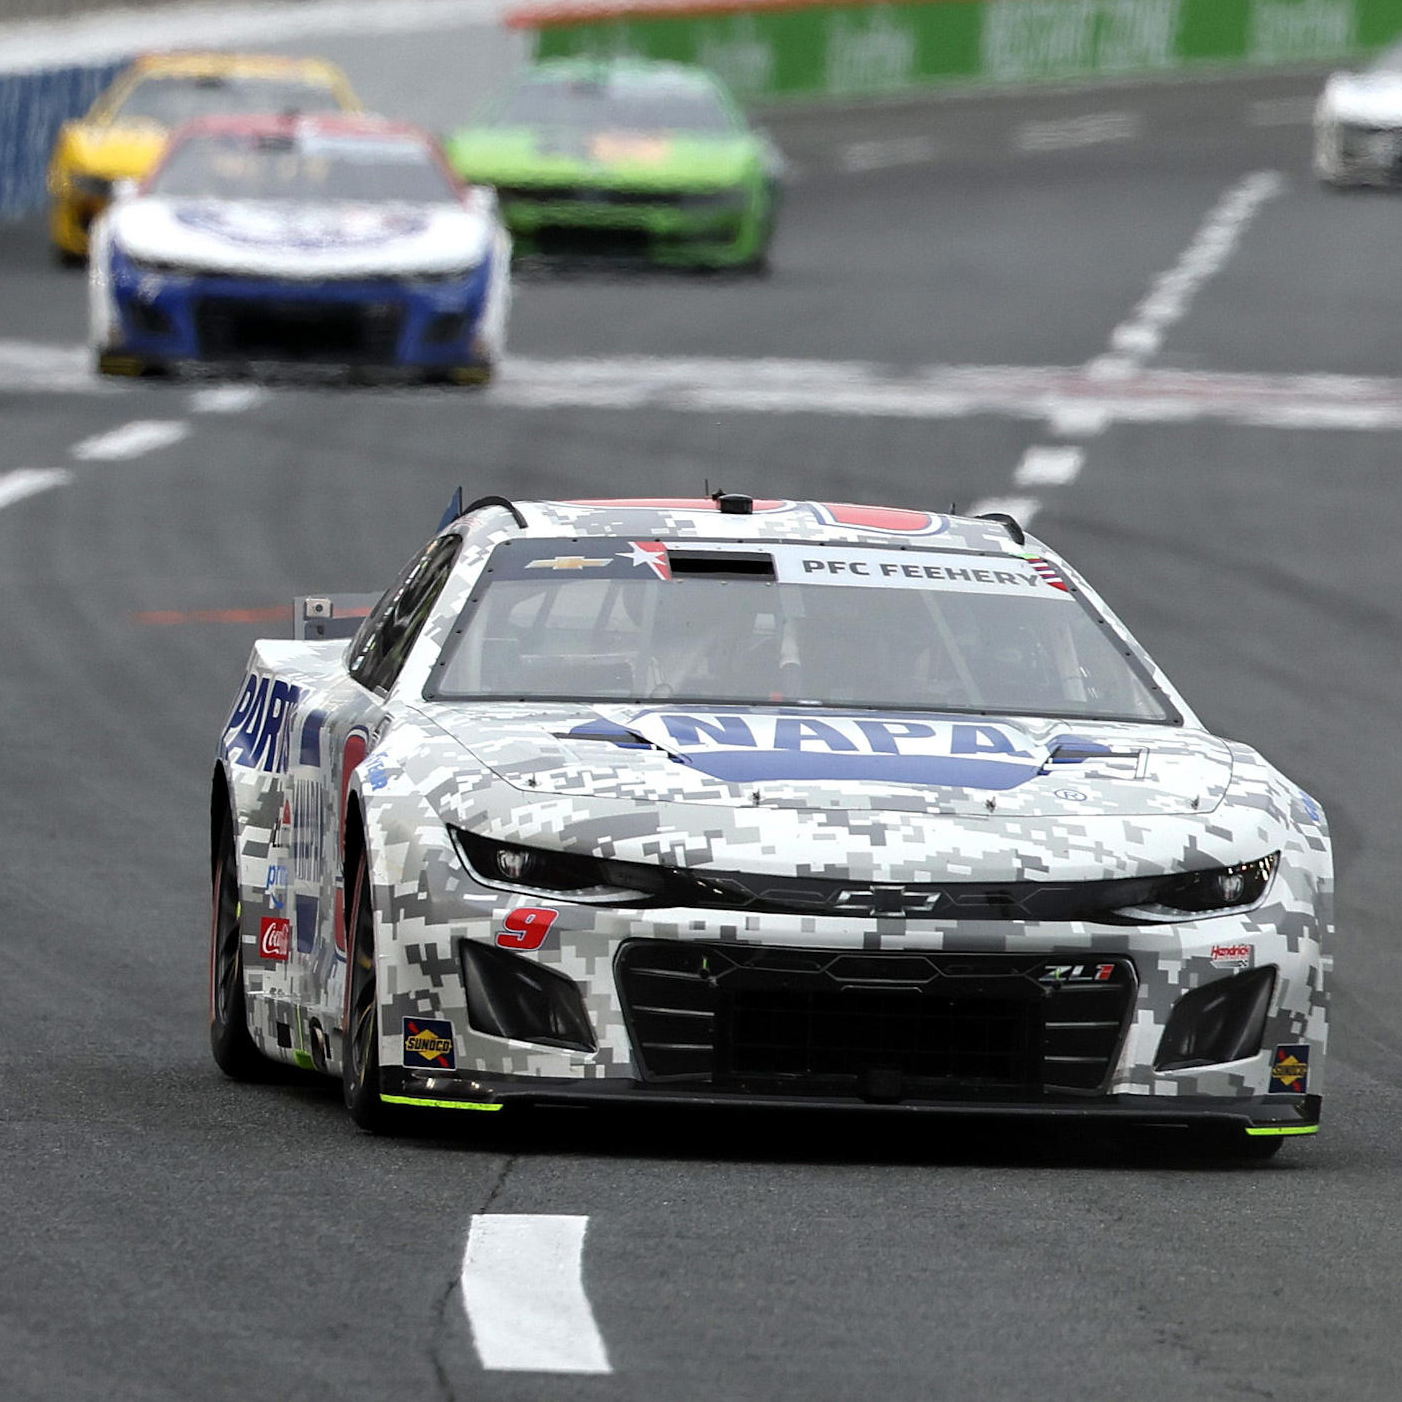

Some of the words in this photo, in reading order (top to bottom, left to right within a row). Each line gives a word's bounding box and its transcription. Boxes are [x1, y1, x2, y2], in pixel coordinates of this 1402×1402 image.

[802, 559, 870, 576] PFC
[879, 563, 1039, 587] FEEHERY
[660, 715, 1034, 758] NAPA
[496, 907, 559, 951] 9
[1038, 963, 1115, 981] ZL1
[407, 1037, 450, 1052] SUNOCO
